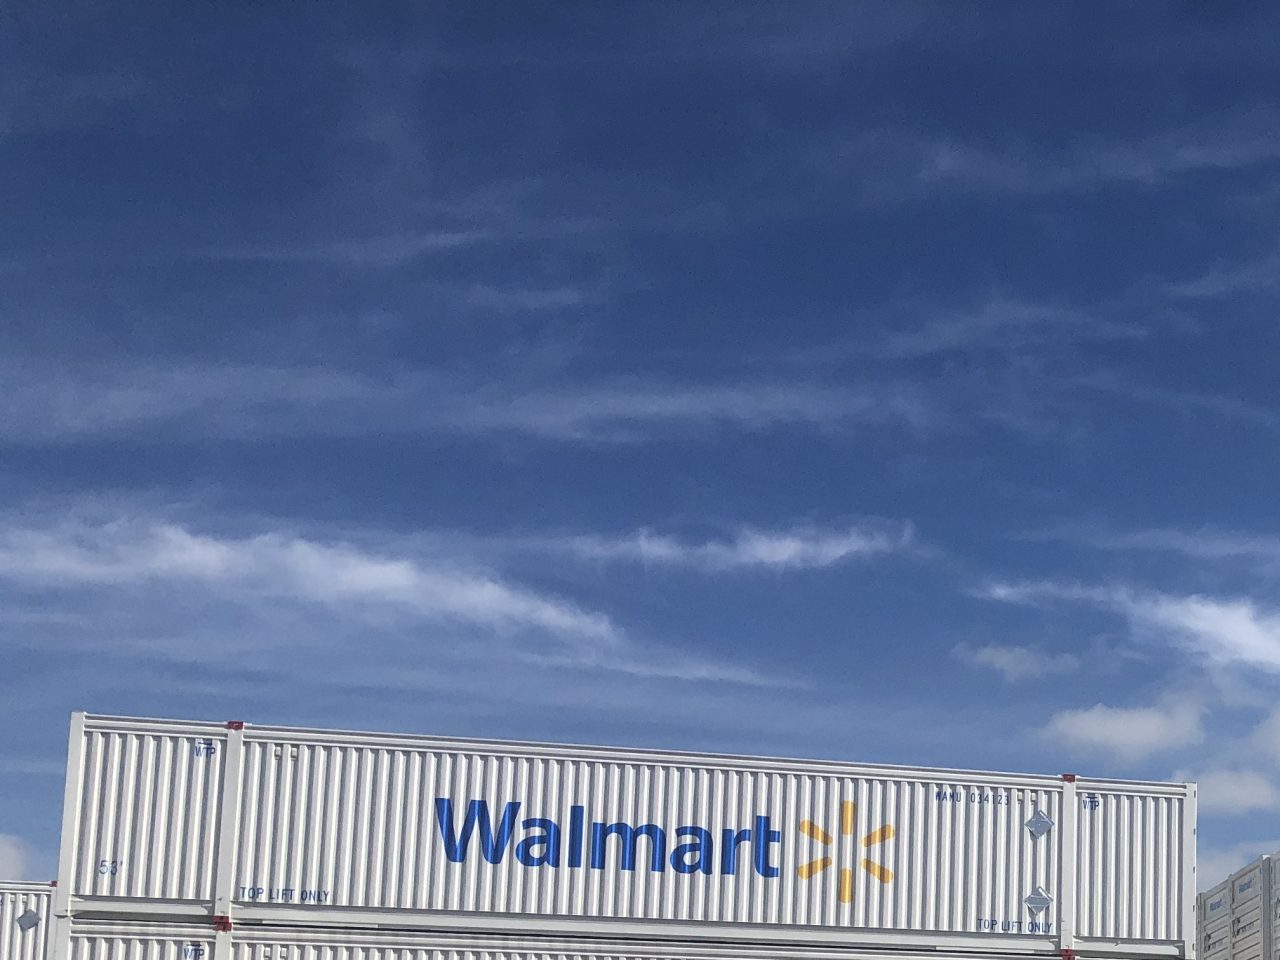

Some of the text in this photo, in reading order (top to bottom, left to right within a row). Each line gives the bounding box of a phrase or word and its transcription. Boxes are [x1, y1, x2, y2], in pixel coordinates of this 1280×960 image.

[434, 797, 780, 878] Walmart
[98, 860, 123, 875] 53'
[240, 887, 330, 902] TOP LIFT ONLY
[977, 918, 1053, 934] TOP LIFT ONLY
